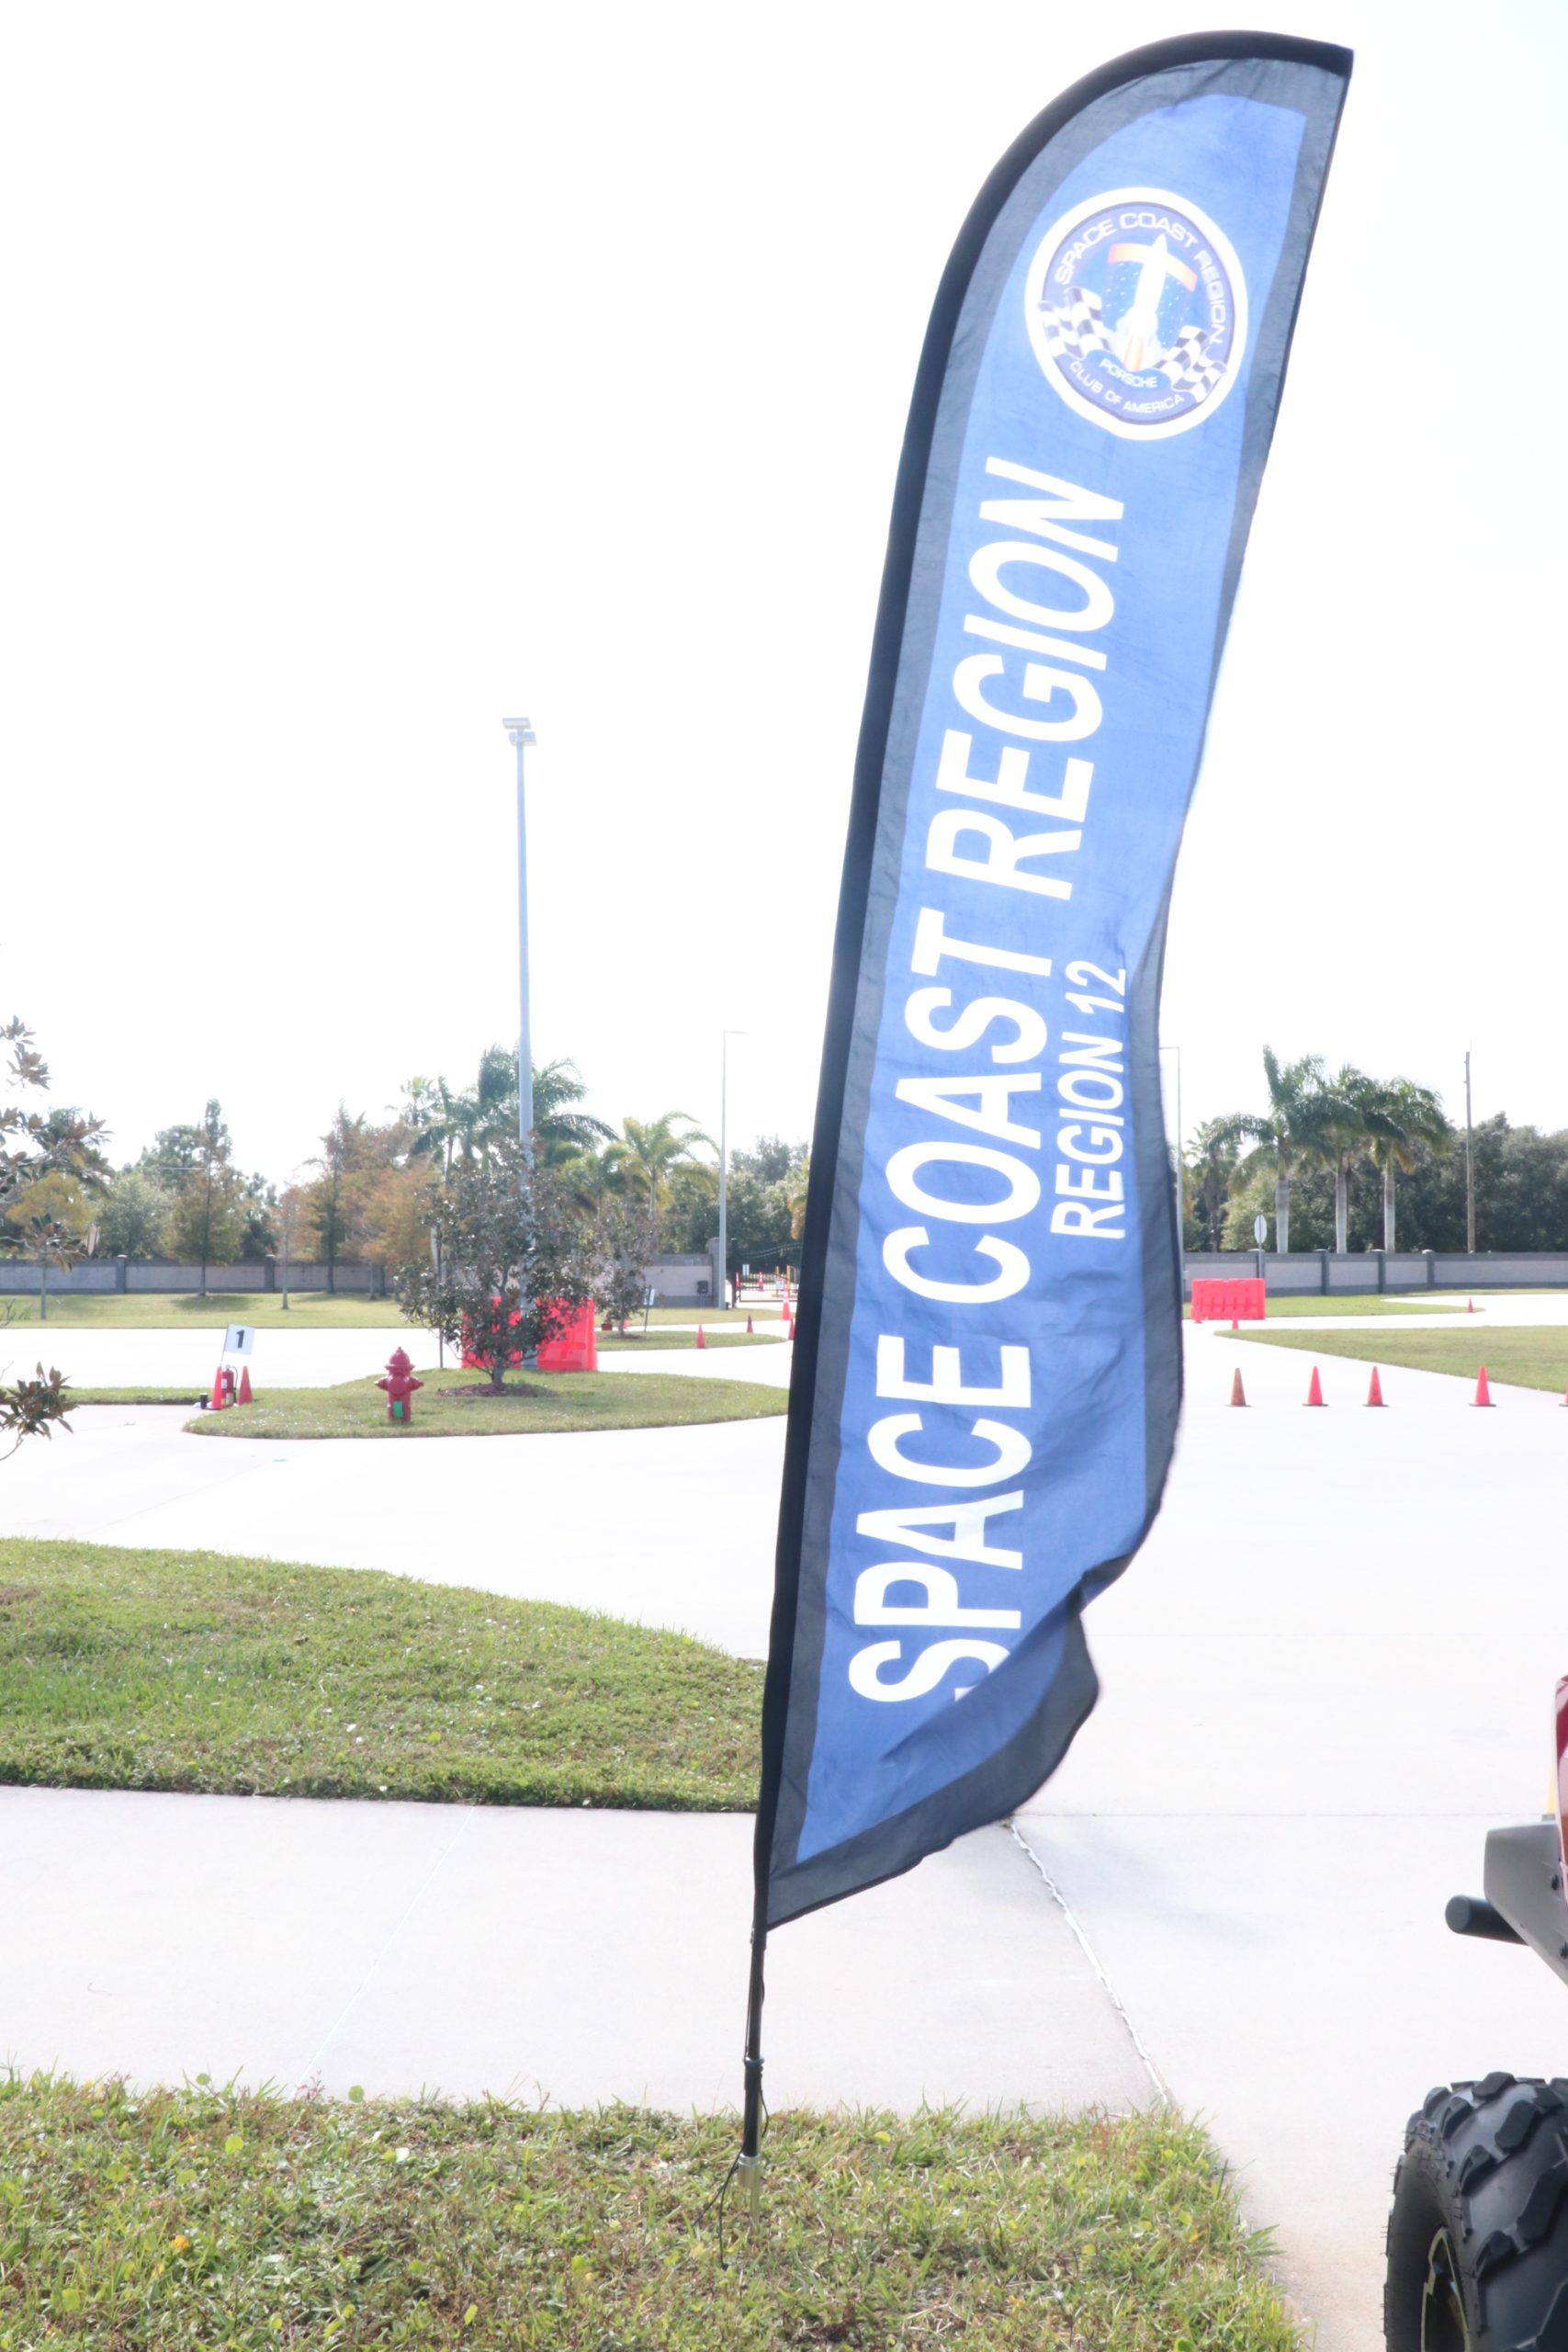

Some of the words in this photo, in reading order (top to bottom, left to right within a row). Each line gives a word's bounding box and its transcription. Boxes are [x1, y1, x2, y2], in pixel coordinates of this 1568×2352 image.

[1055, 218, 1117, 285] SPACE
[1119, 212, 1199, 248] COAST
[1195, 250, 1226, 345] REGION
[1069, 360, 1103, 392] CLUB
[1105, 390, 1122, 405] OF
[1122, 393, 1185, 414] AMERICA
[1099, 358, 1158, 389] PORSCHE
[925, 456, 1124, 901] REGION
[1065, 960, 1126, 1013] 12
[882, 907, 1054, 1304] COAST
[1050, 1031, 1125, 1239] REGION
[236, 1329, 245, 1349] 1
[848, 1334, 1033, 1702] SPACE
